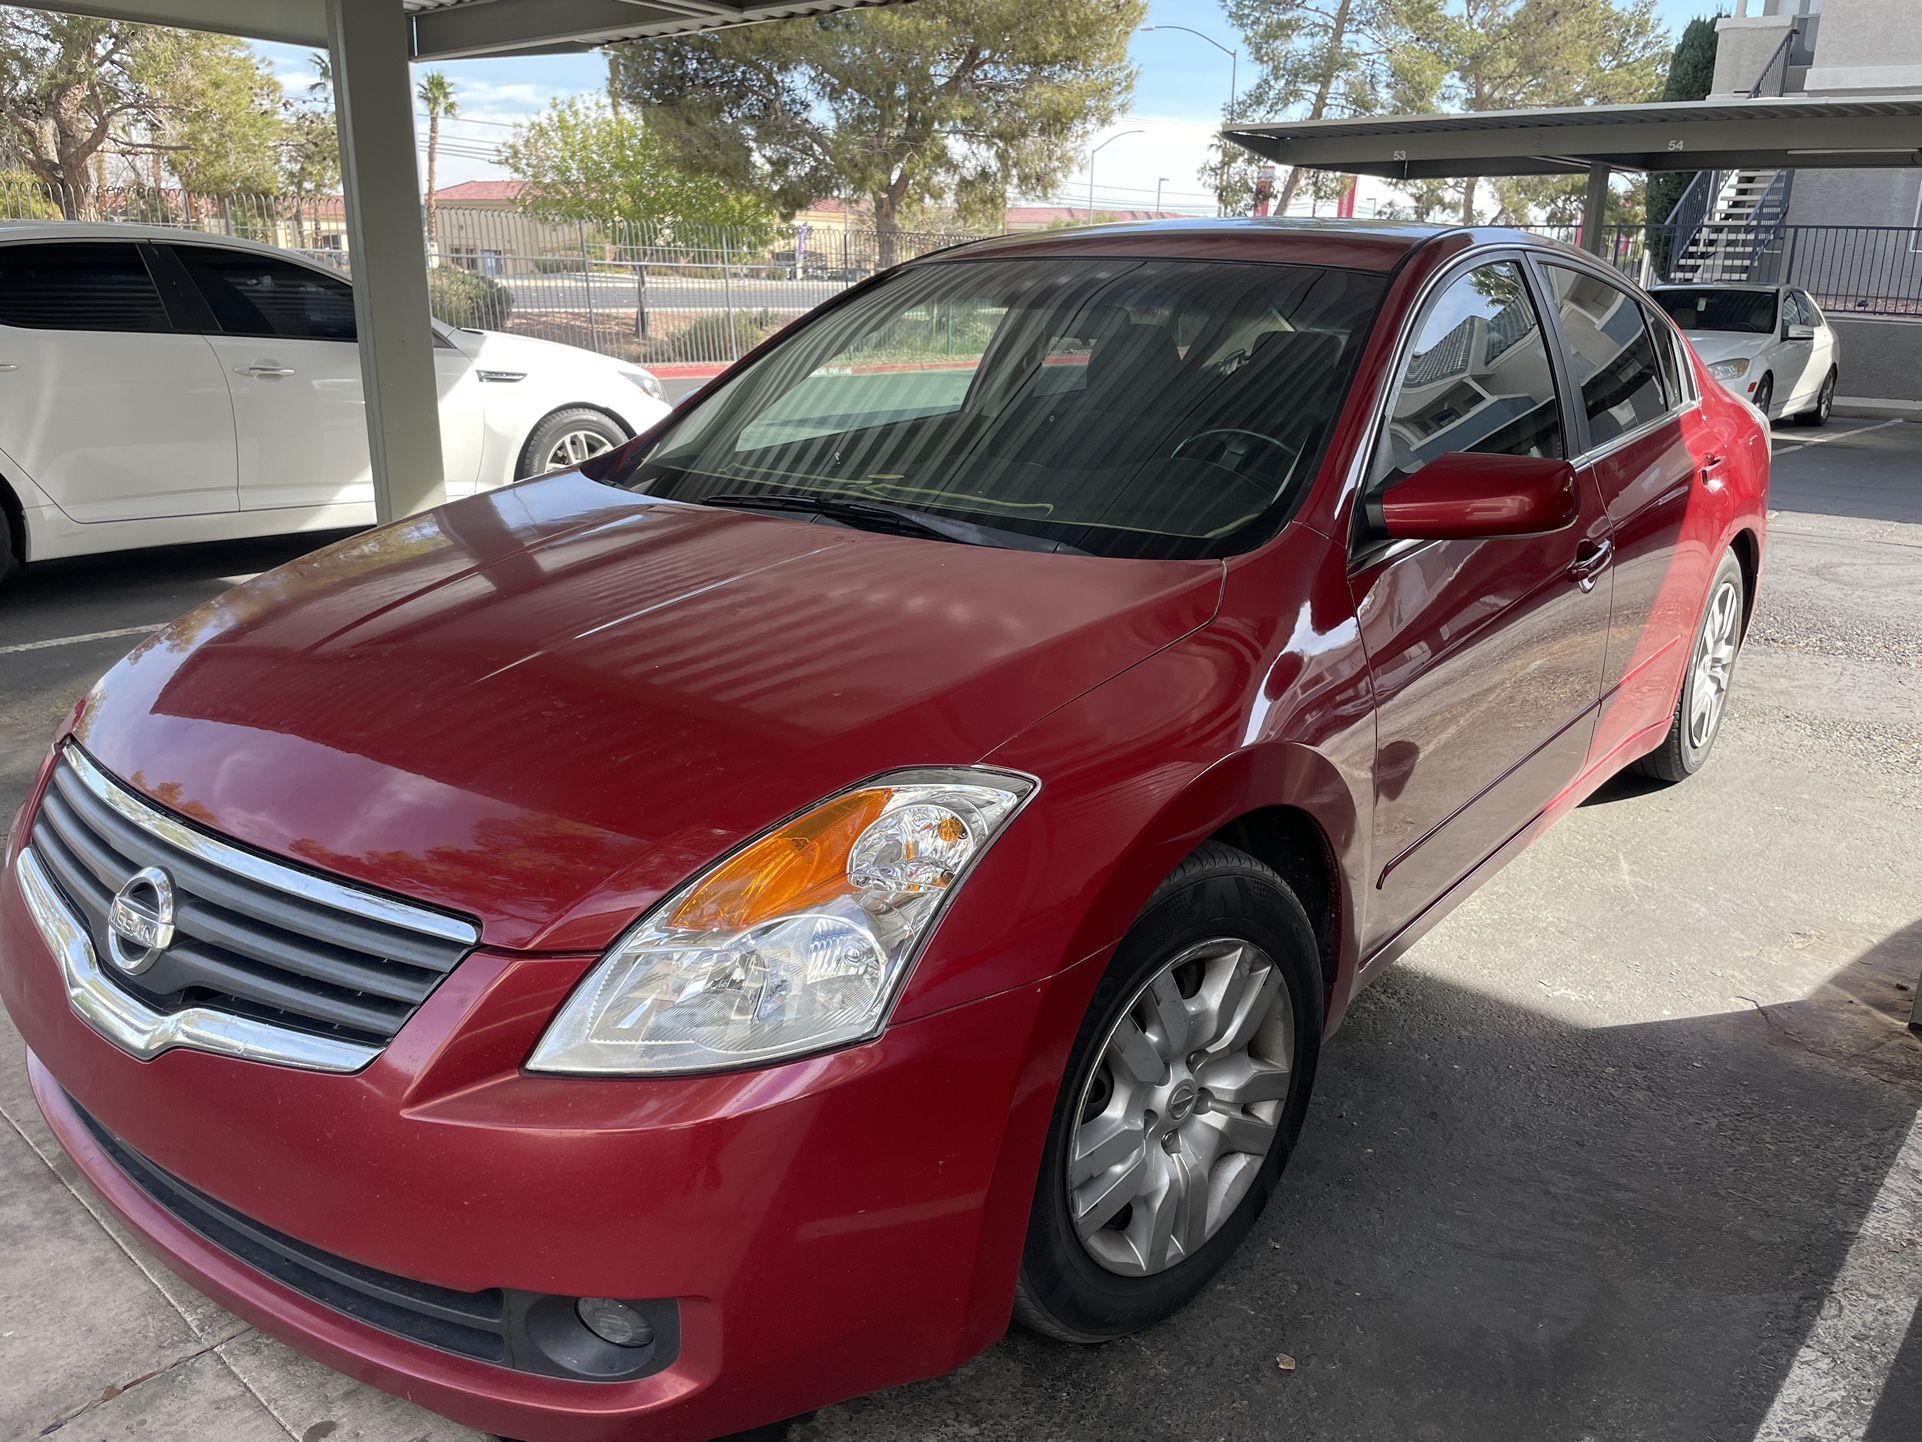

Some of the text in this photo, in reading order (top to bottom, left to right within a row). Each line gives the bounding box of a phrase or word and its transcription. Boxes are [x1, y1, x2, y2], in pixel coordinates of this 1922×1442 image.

[1667, 139, 1684, 151] 54
[1393, 150, 1406, 161] 53
[110, 905, 157, 947] NISSAN
